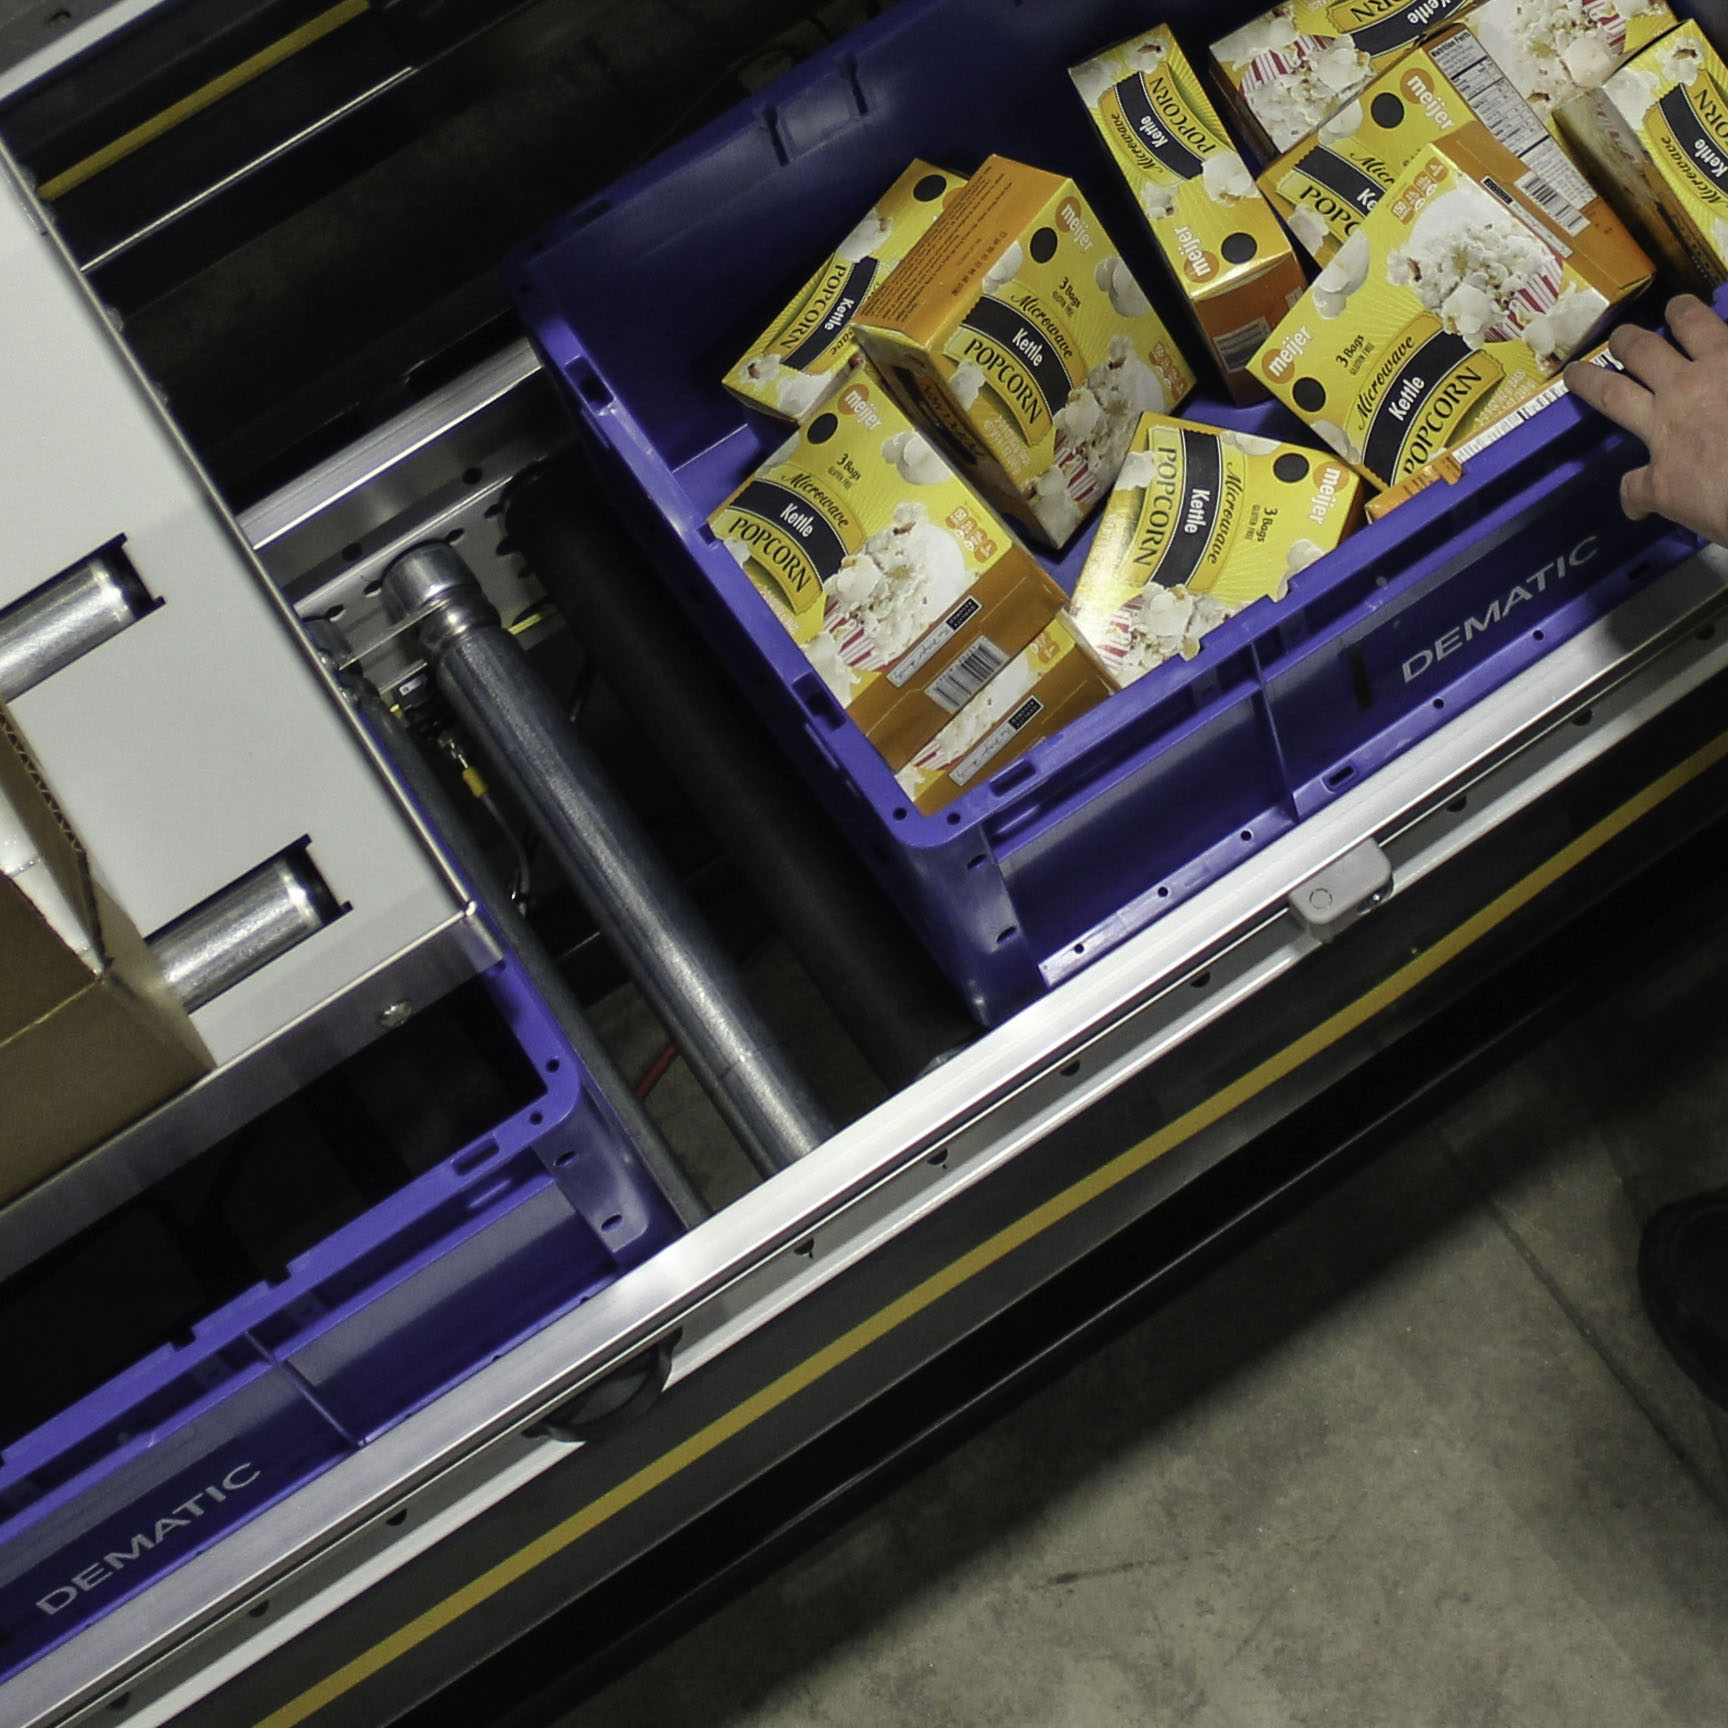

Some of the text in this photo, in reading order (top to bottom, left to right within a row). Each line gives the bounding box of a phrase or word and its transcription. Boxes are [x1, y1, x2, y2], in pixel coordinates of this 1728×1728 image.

[1150, 77, 1216, 155] POPCORN
[1407, 75, 1455, 130] meijer
[1111, 113, 1163, 173] Microwave
[1140, 115, 1168, 148] Kettle
[1694, 138, 1728, 178] Kettle
[1061, 204, 1095, 252] meijer
[1300, 186, 1361, 237] POPC
[1175, 226, 1211, 276] meijer
[780, 265, 846, 349] POPCORN
[824, 298, 854, 330] Kettle
[1059, 276, 1081, 308] 3 Bags
[1011, 293, 1073, 360] Microwave
[1012, 328, 1043, 367] Kettle
[1268, 324, 1313, 377] meijer
[1336, 334, 1365, 368] 3 Bags
[964, 338, 1042, 425] POPCORN
[1358, 335, 1415, 430] Microwave
[1388, 376, 1425, 422] Kettle
[844, 390, 882, 430] meijer
[1403, 366, 1482, 474] POPCORN
[837, 453, 861, 482] 3 Bags
[780, 502, 813, 538] Kettle
[781, 472, 848, 528] Microwave
[1134, 447, 1176, 566] POPCORN
[1184, 488, 1210, 534] Kettle
[1208, 462, 1243, 565] Microwave
[1311, 467, 1341, 525] meijer
[1257, 507, 1277, 543] 3 Bags
[728, 516, 811, 592] POPCORN
[1402, 536, 1600, 684] DEMATIC
[36, 1462, 261, 1616] DEMATIC
